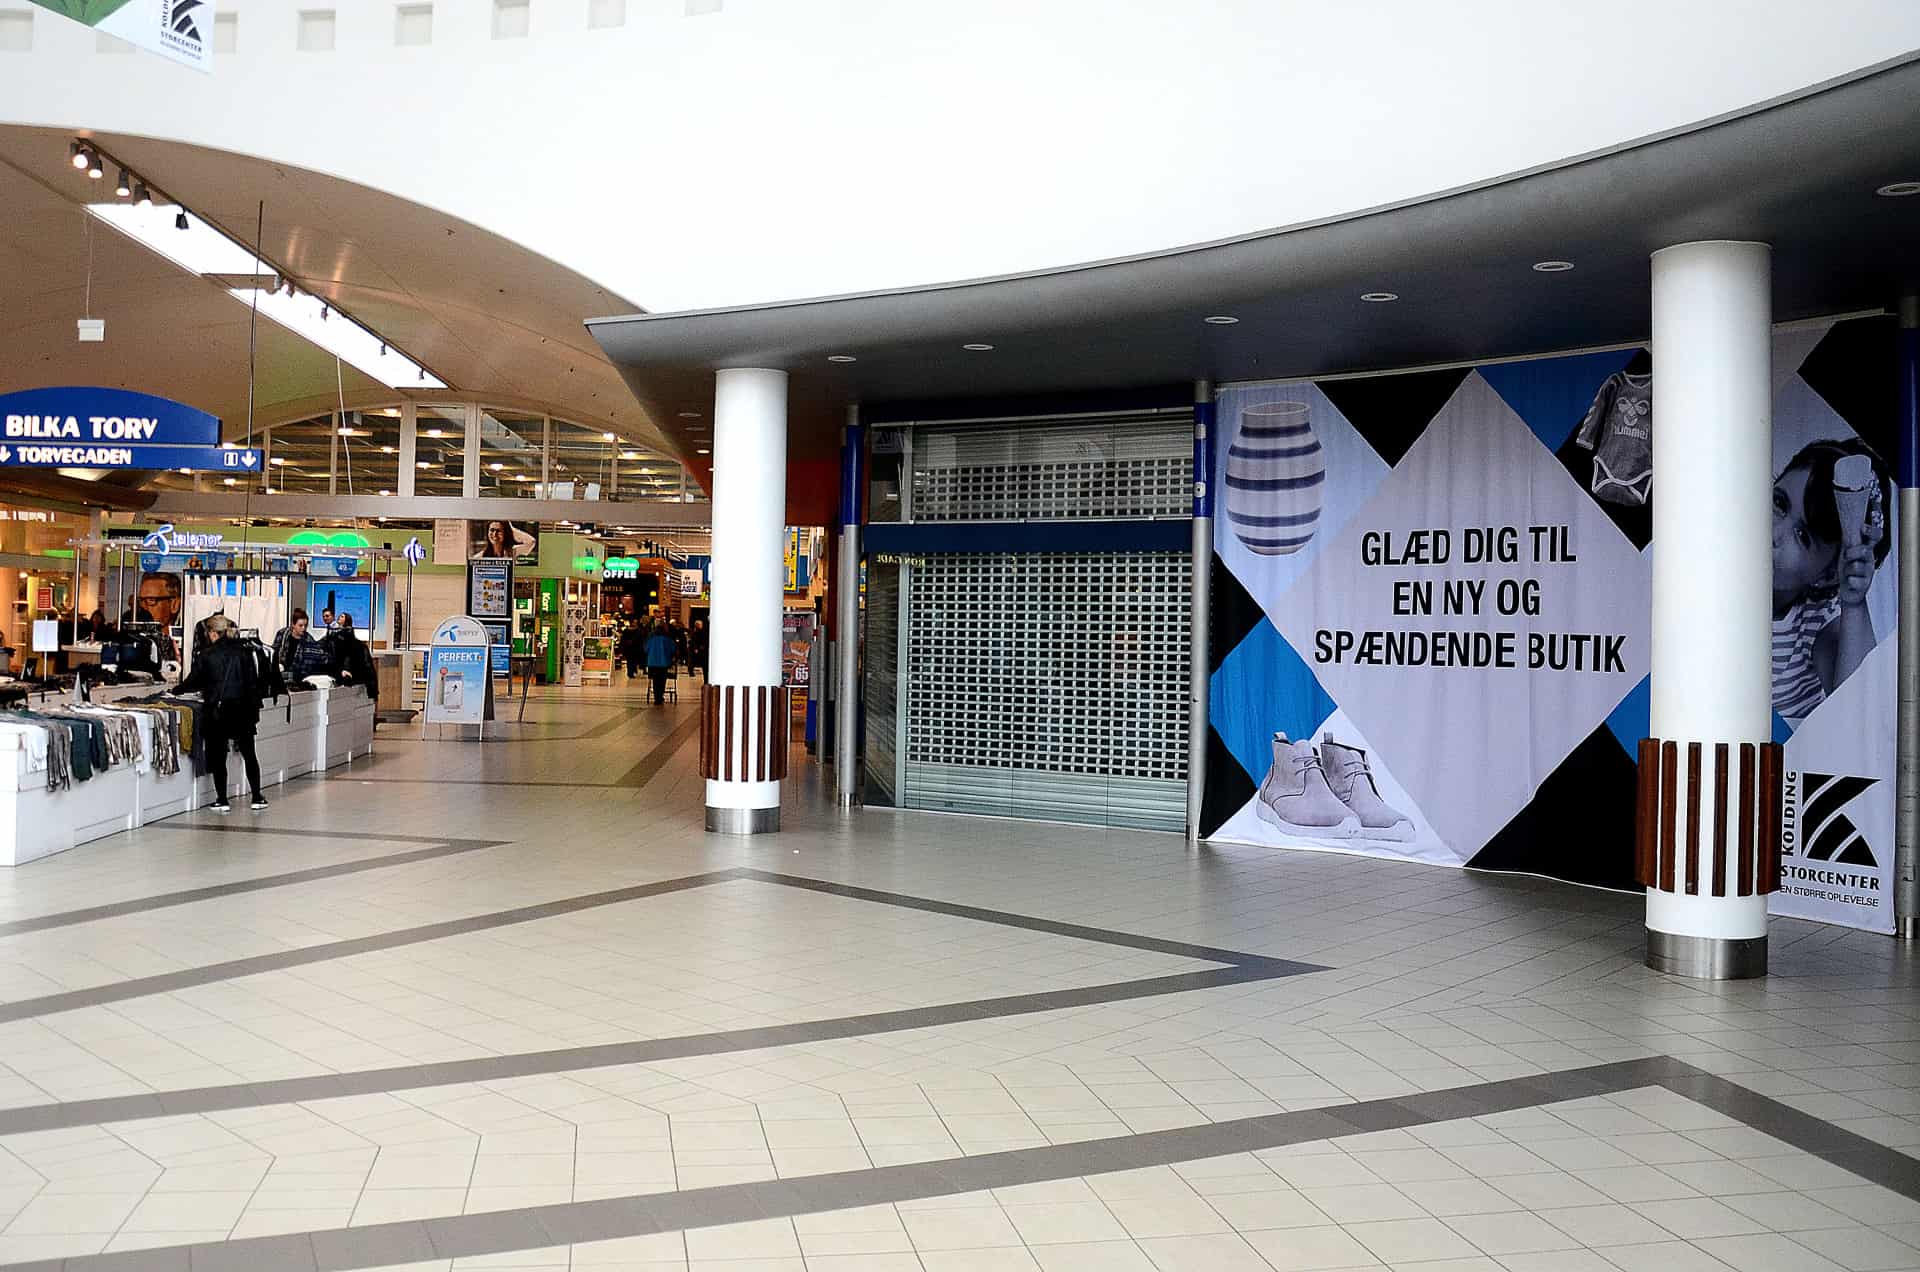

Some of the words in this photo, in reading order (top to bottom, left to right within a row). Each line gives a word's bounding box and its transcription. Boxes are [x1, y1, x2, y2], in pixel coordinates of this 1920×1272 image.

[5, 414, 81, 438] BILKA
[89, 416, 158, 439] TORV
[16, 446, 132, 465] TORVEGADEN
[1362, 530, 1450, 565] GLÆD
[1463, 527, 1518, 562] DIG
[1529, 526, 1576, 561] TIL
[603, 569, 637, 579] OFFEE
[1393, 581, 1432, 615] EN
[1444, 581, 1485, 614] NY
[1497, 580, 1541, 615] OG
[438, 652, 478, 662] PERFEKT
[1314, 630, 1515, 667] SPÆNDENDE
[1529, 633, 1626, 672] BUTIK
[1782, 771, 1797, 856] KOLDING
[1780, 865, 1880, 890] STORCENTER
[1828, 892, 1879, 907] OPLEVELSE
